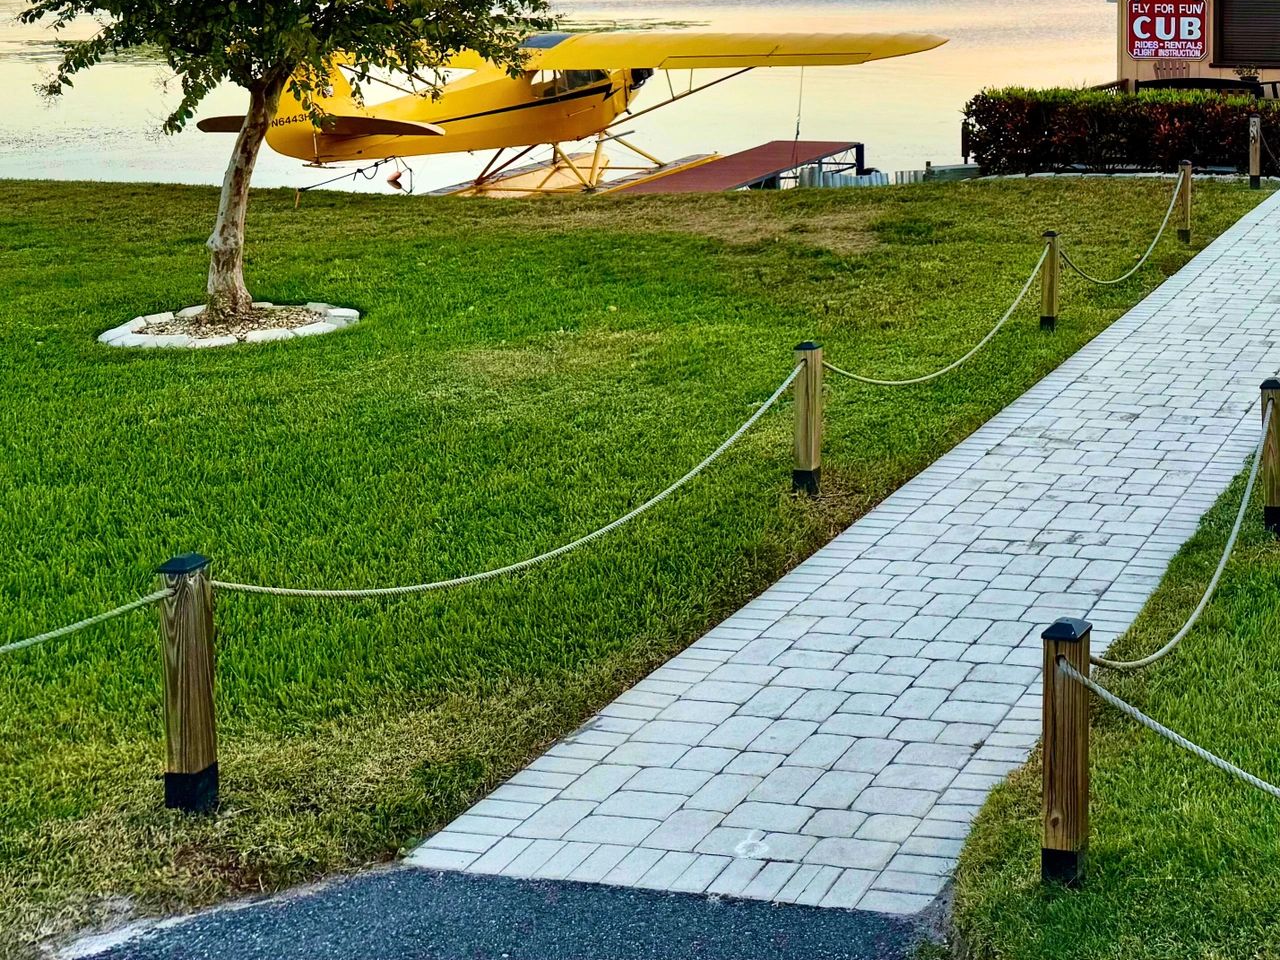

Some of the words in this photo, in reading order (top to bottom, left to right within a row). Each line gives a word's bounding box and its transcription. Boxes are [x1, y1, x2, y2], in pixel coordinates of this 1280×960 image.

[1132, 3, 1150, 13] FLY
[1154, 4, 1175, 14] FOR
[1132, 15, 1202, 40] CUB
[1133, 48, 1155, 57] FLIGHT
[1158, 49, 1201, 57] INSTRUCTION
